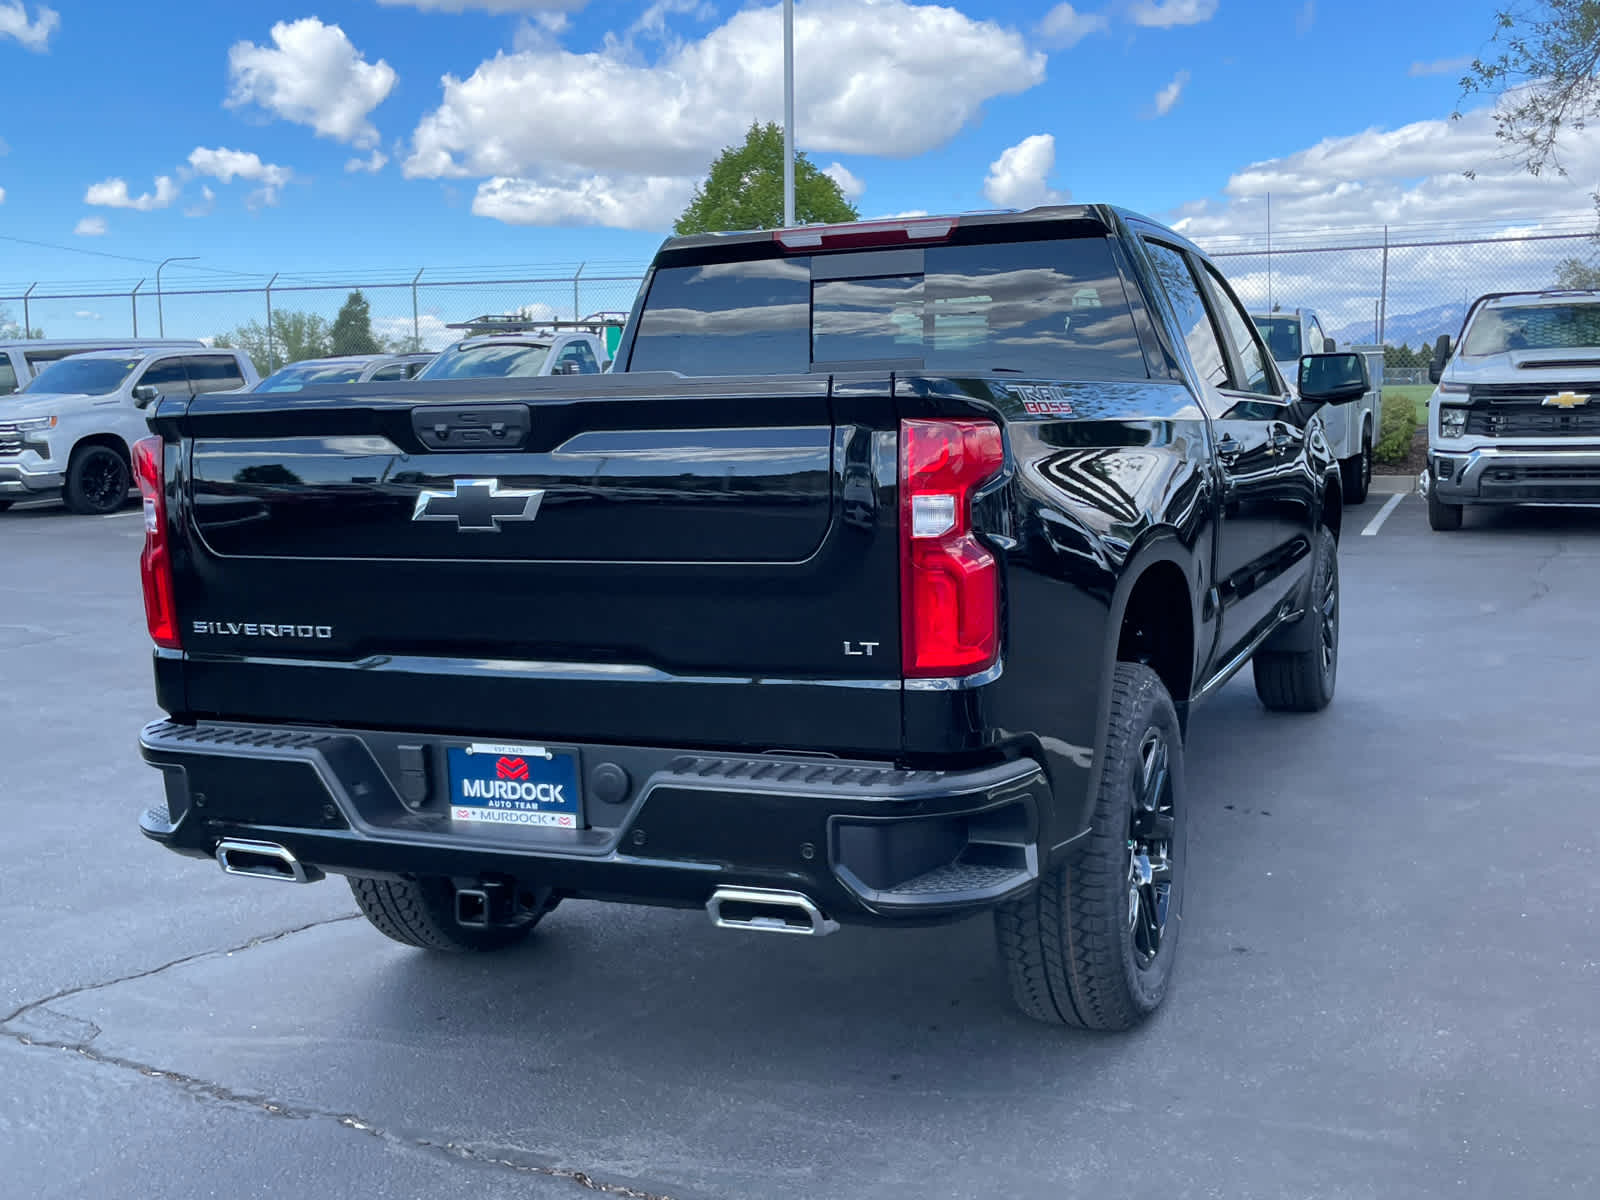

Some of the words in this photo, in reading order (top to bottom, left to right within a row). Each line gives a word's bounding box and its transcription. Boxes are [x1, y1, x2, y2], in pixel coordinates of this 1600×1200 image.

[1006, 385, 1072, 401] TRAIL
[1024, 401, 1072, 414] BOSS
[193, 621, 332, 638] SILVERADO
[843, 641, 880, 656] LT
[463, 779, 565, 803] MURDOCK
[488, 799, 512, 809] AUTO
[514, 801, 539, 810] TEAM
[480, 810, 549, 825] MURDOCK
